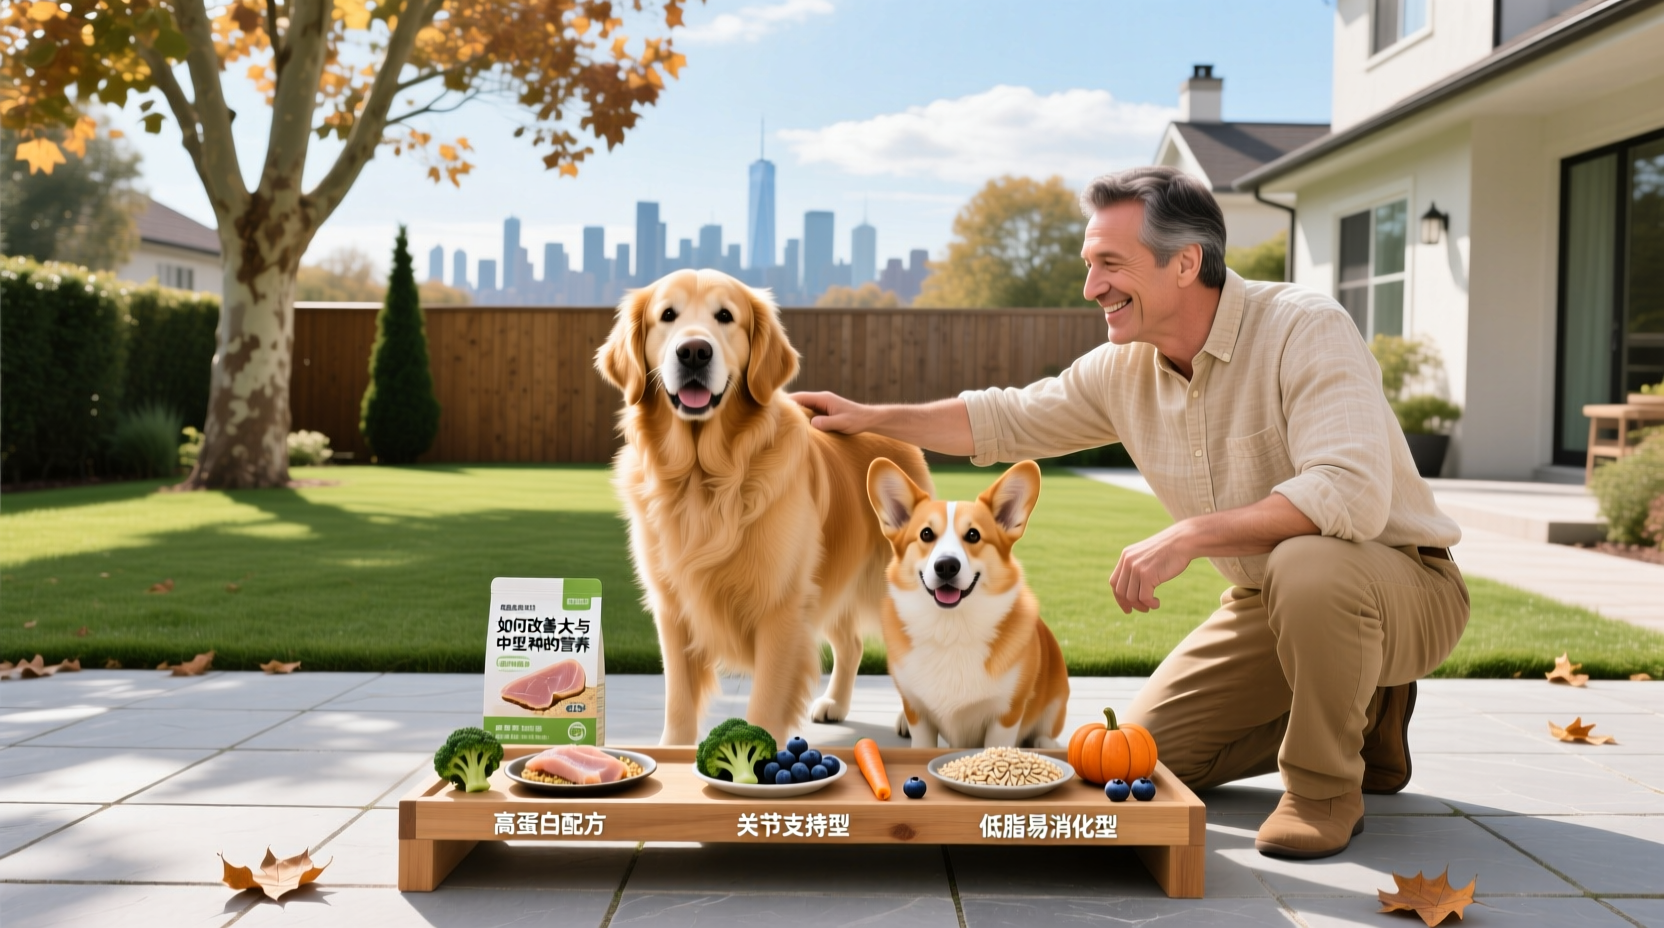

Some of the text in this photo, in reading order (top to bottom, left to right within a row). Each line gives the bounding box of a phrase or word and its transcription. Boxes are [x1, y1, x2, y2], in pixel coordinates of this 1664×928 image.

[494, 811, 606, 835] 高蛋白配方
[737, 812, 850, 837] 关节支持型
[979, 813, 1117, 839] 低脂易消化型
